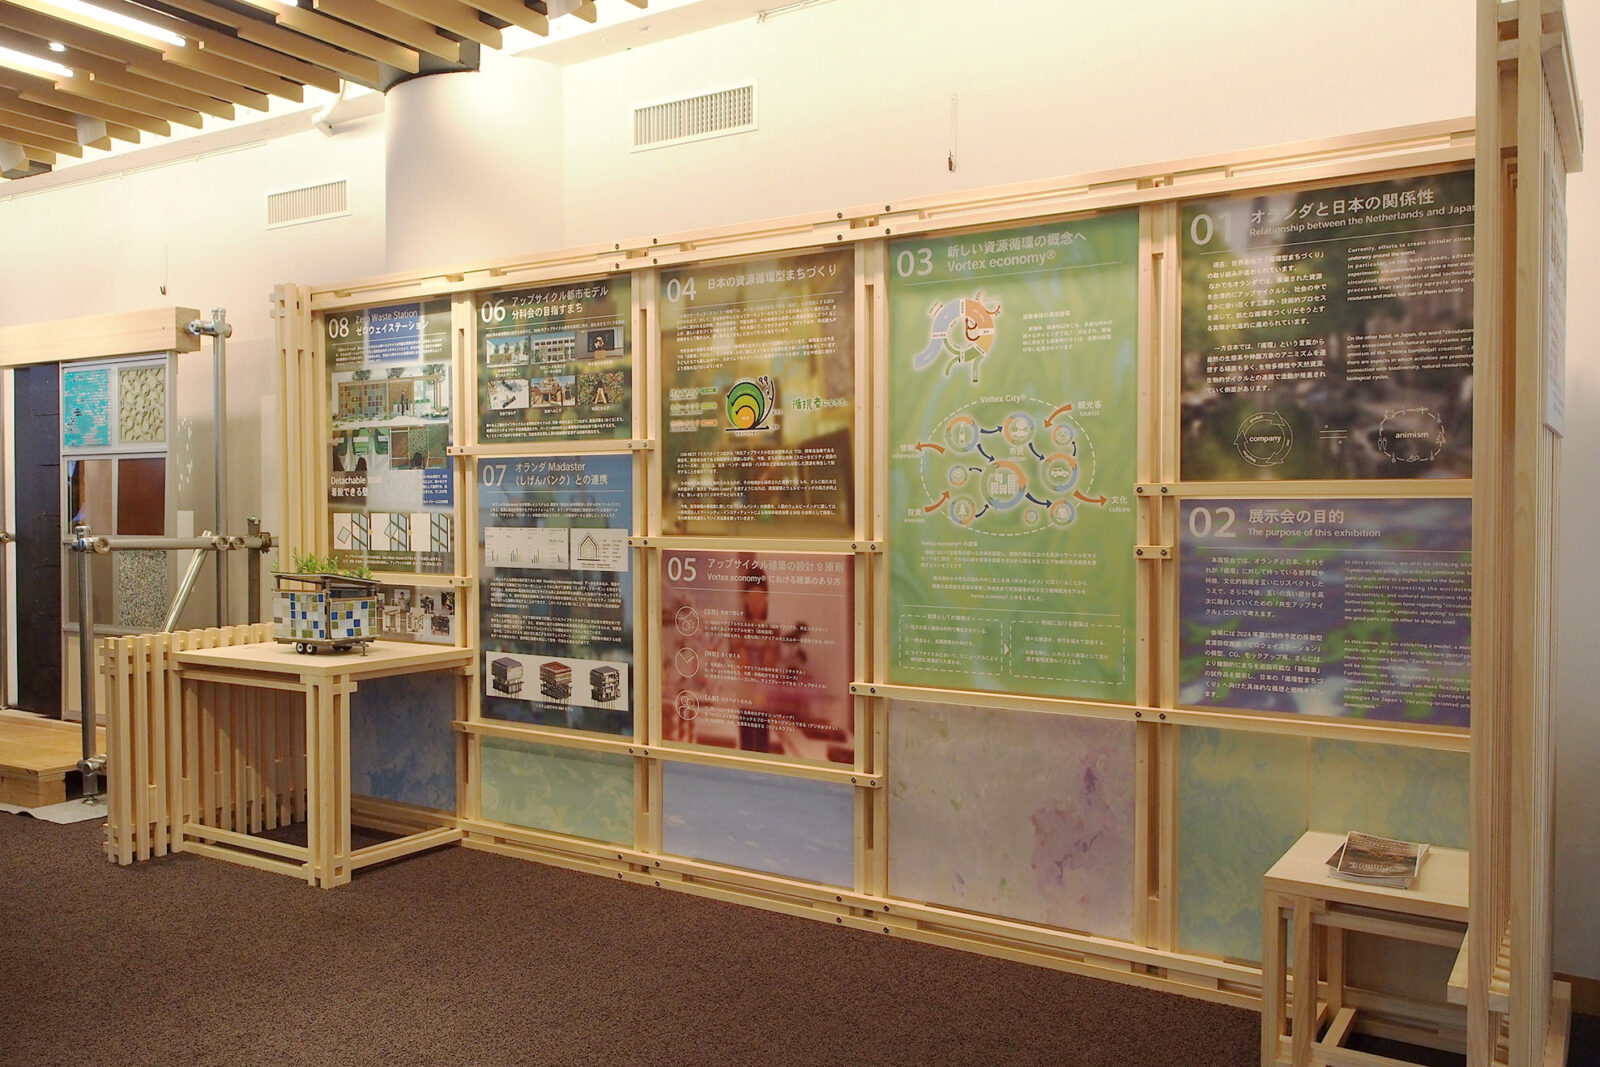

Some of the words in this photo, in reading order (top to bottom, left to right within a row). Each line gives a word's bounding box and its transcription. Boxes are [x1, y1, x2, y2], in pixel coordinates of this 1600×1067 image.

[1251, 188, 1434, 224] オランダと日本の関係性
[1190, 212, 1232, 246] 01
[1250, 222, 1304, 236] Relationship
[1307, 218, 1346, 231] between
[1348, 216, 1362, 227] the
[1366, 210, 1424, 224] Netherlands
[1426, 206, 1445, 217] and
[947, 231, 1087, 258] 新しい資源循環の概念へ
[897, 248, 934, 278] 03
[947, 259, 986, 272] Vortex
[708, 264, 837, 290] 日本の資源循環型まちづくり
[512, 285, 608, 307] アップサイクル都市モデル
[667, 277, 696, 302] 04
[372, 312, 392, 322] Waste
[394, 310, 418, 319] Station
[481, 300, 506, 323] 06
[512, 303, 583, 320] 分科会の目指すまち
[329, 318, 349, 338] 08
[356, 321, 429, 336] ゼロウェイステーション
[483, 464, 507, 486] 07
[515, 462, 544, 471] オランダ
[548, 462, 585, 471] Madaster
[330, 476, 367, 485] Detachable
[515, 474, 608, 486] （しげんバンク）との連携
[1111, 496, 1128, 505] 文化
[1189, 507, 1237, 538] 02
[1249, 509, 1344, 524] 展示会の目的
[1248, 528, 1263, 536] The
[1265, 530, 1301, 539] purpose
[1314, 529, 1331, 537] this
[1334, 529, 1381, 538] exhibition
[668, 557, 697, 582] 05
[769, 576, 841, 586] における建築のあり方
